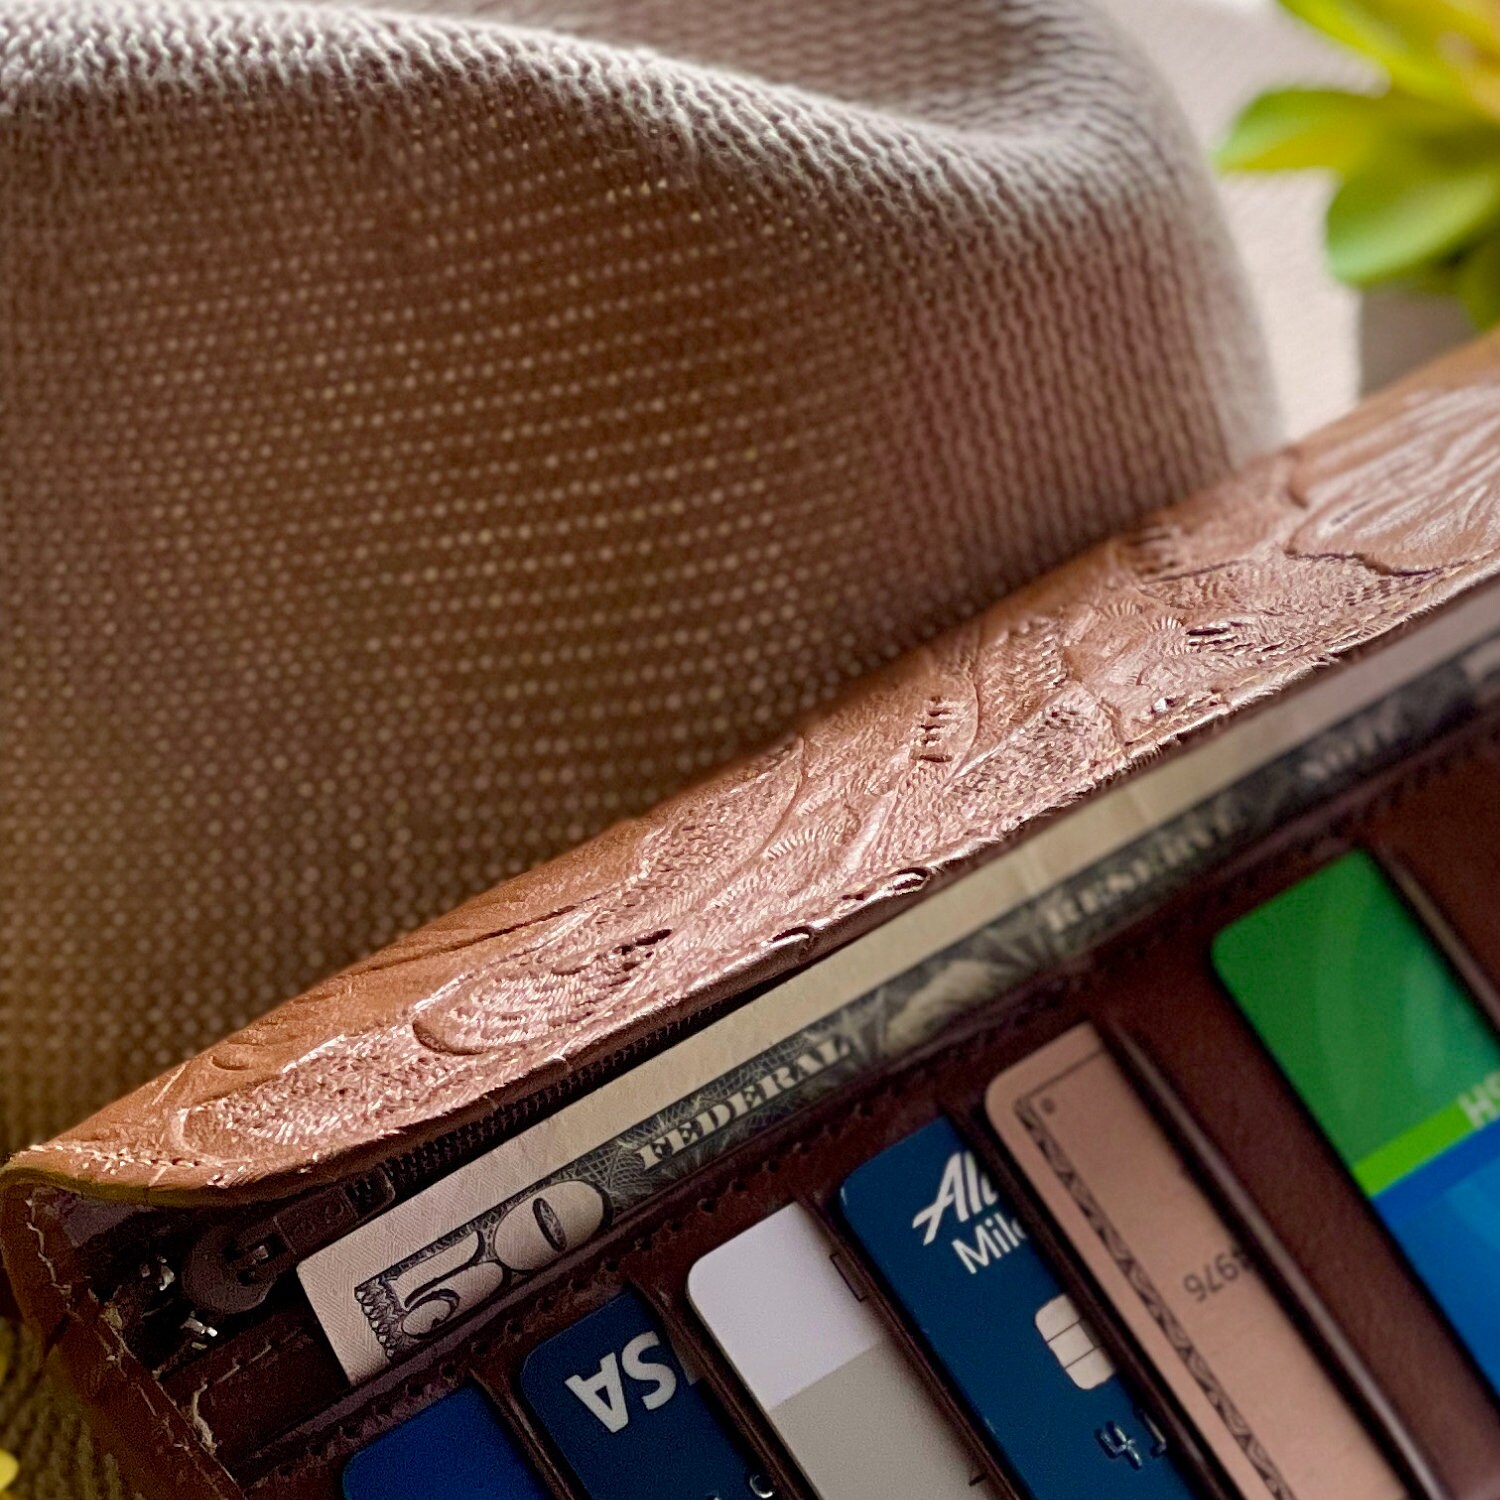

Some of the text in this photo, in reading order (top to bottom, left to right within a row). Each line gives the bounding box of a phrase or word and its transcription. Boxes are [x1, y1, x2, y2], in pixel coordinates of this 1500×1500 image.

[636, 1036, 852, 1170] FEDERAL
[392, 1178, 605, 1338] 50
[1184, 1247, 1249, 1302] 976
